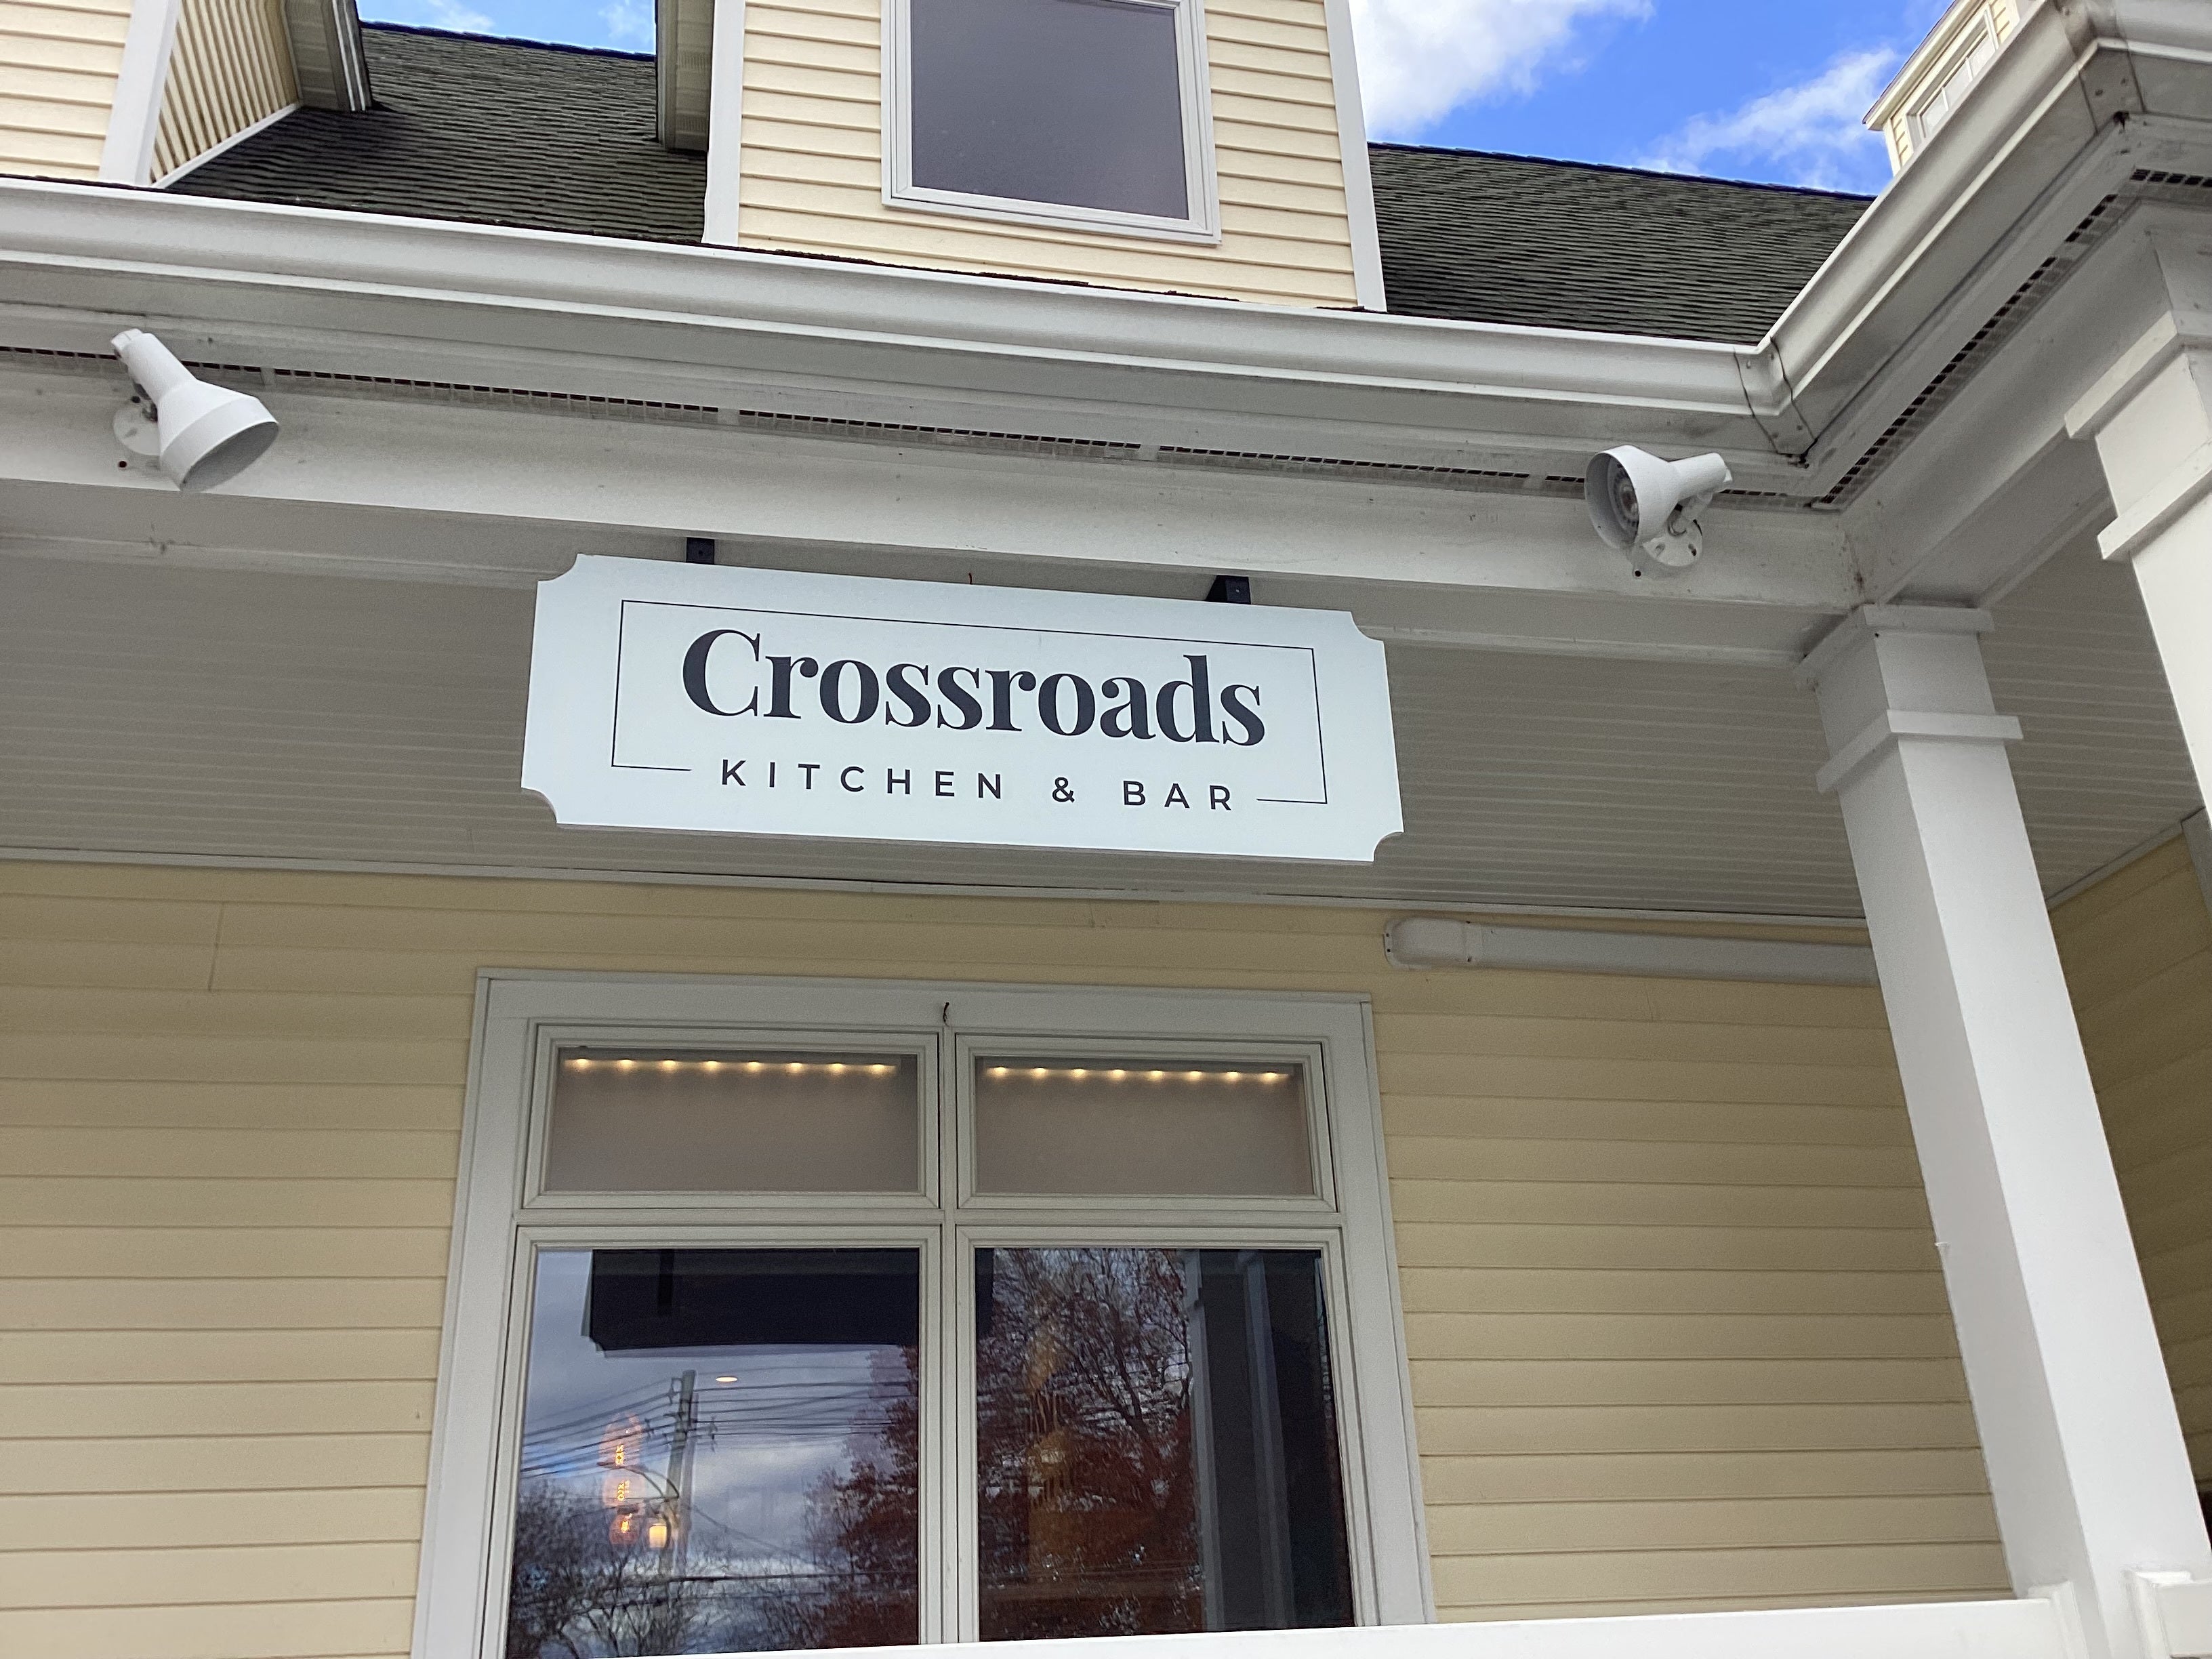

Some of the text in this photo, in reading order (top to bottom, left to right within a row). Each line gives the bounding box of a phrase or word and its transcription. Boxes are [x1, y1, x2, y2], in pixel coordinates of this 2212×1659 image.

[682, 628, 1266, 747] Crossroads
[721, 758, 1233, 811] KITCHEN & BAR
